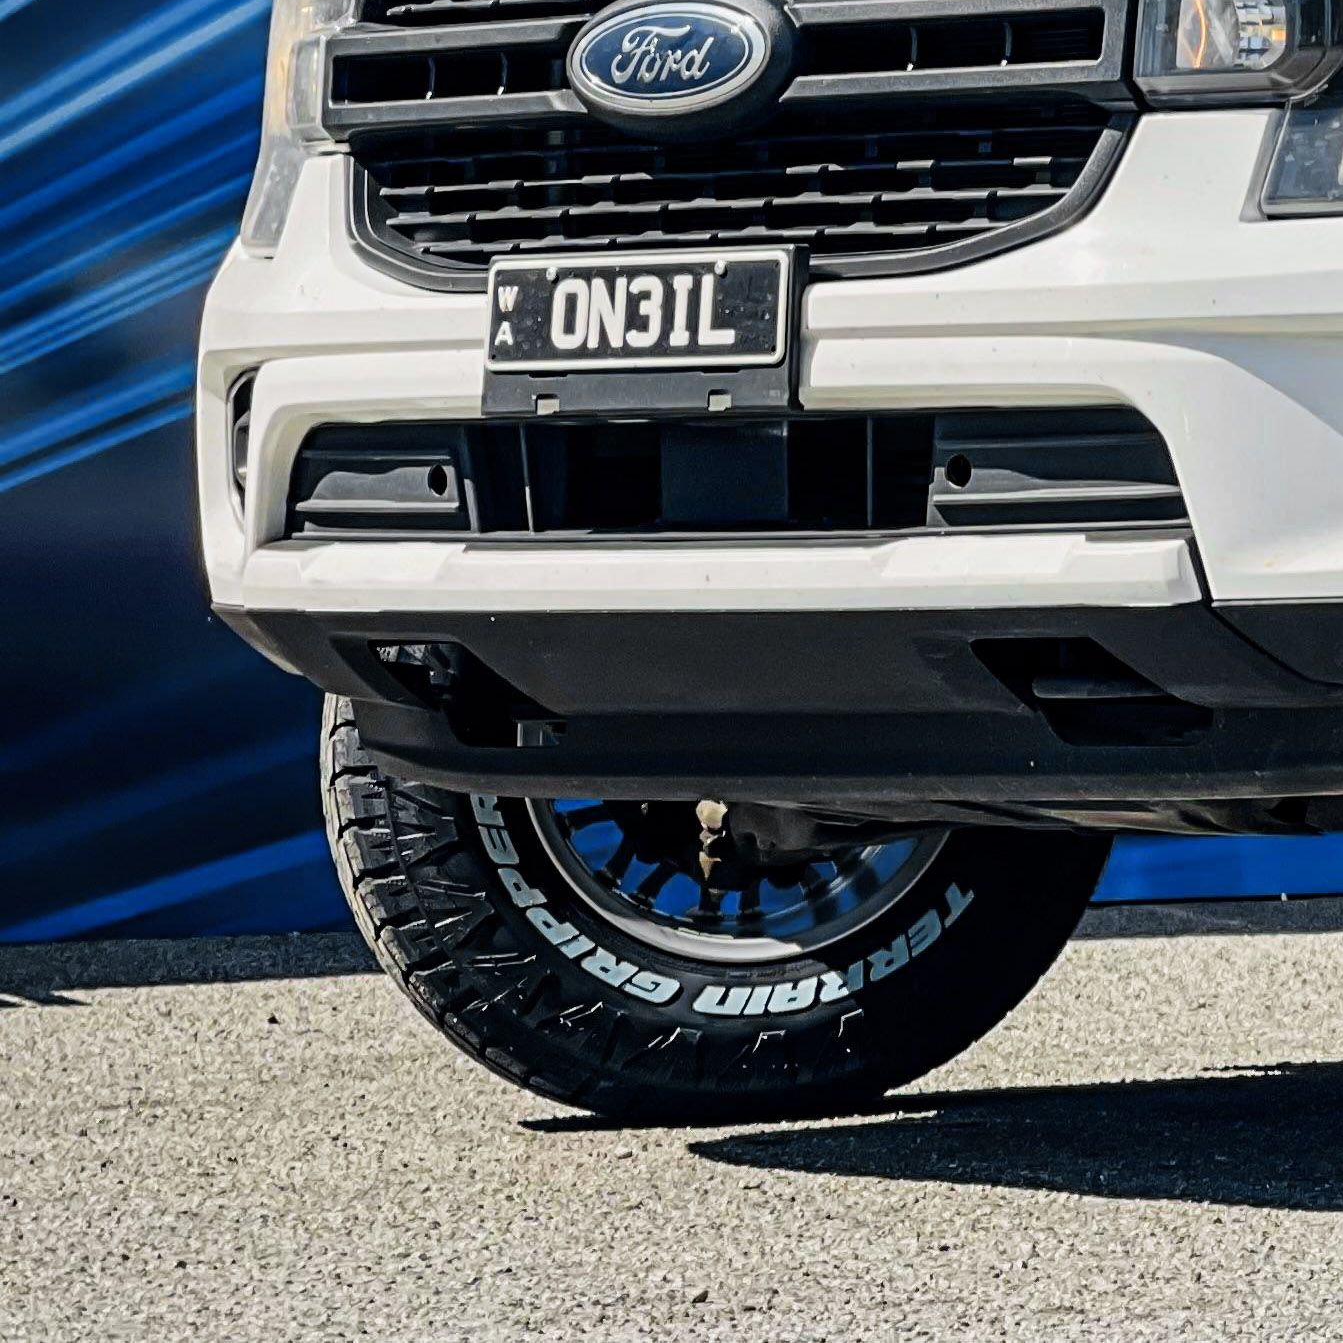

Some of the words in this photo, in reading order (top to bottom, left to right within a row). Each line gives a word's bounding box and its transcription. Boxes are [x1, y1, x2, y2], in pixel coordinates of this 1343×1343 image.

[611, 25, 714, 84] Ford
[470, 792, 681, 1004] GRIPPER
[692, 882, 975, 1015] TERRAIN
